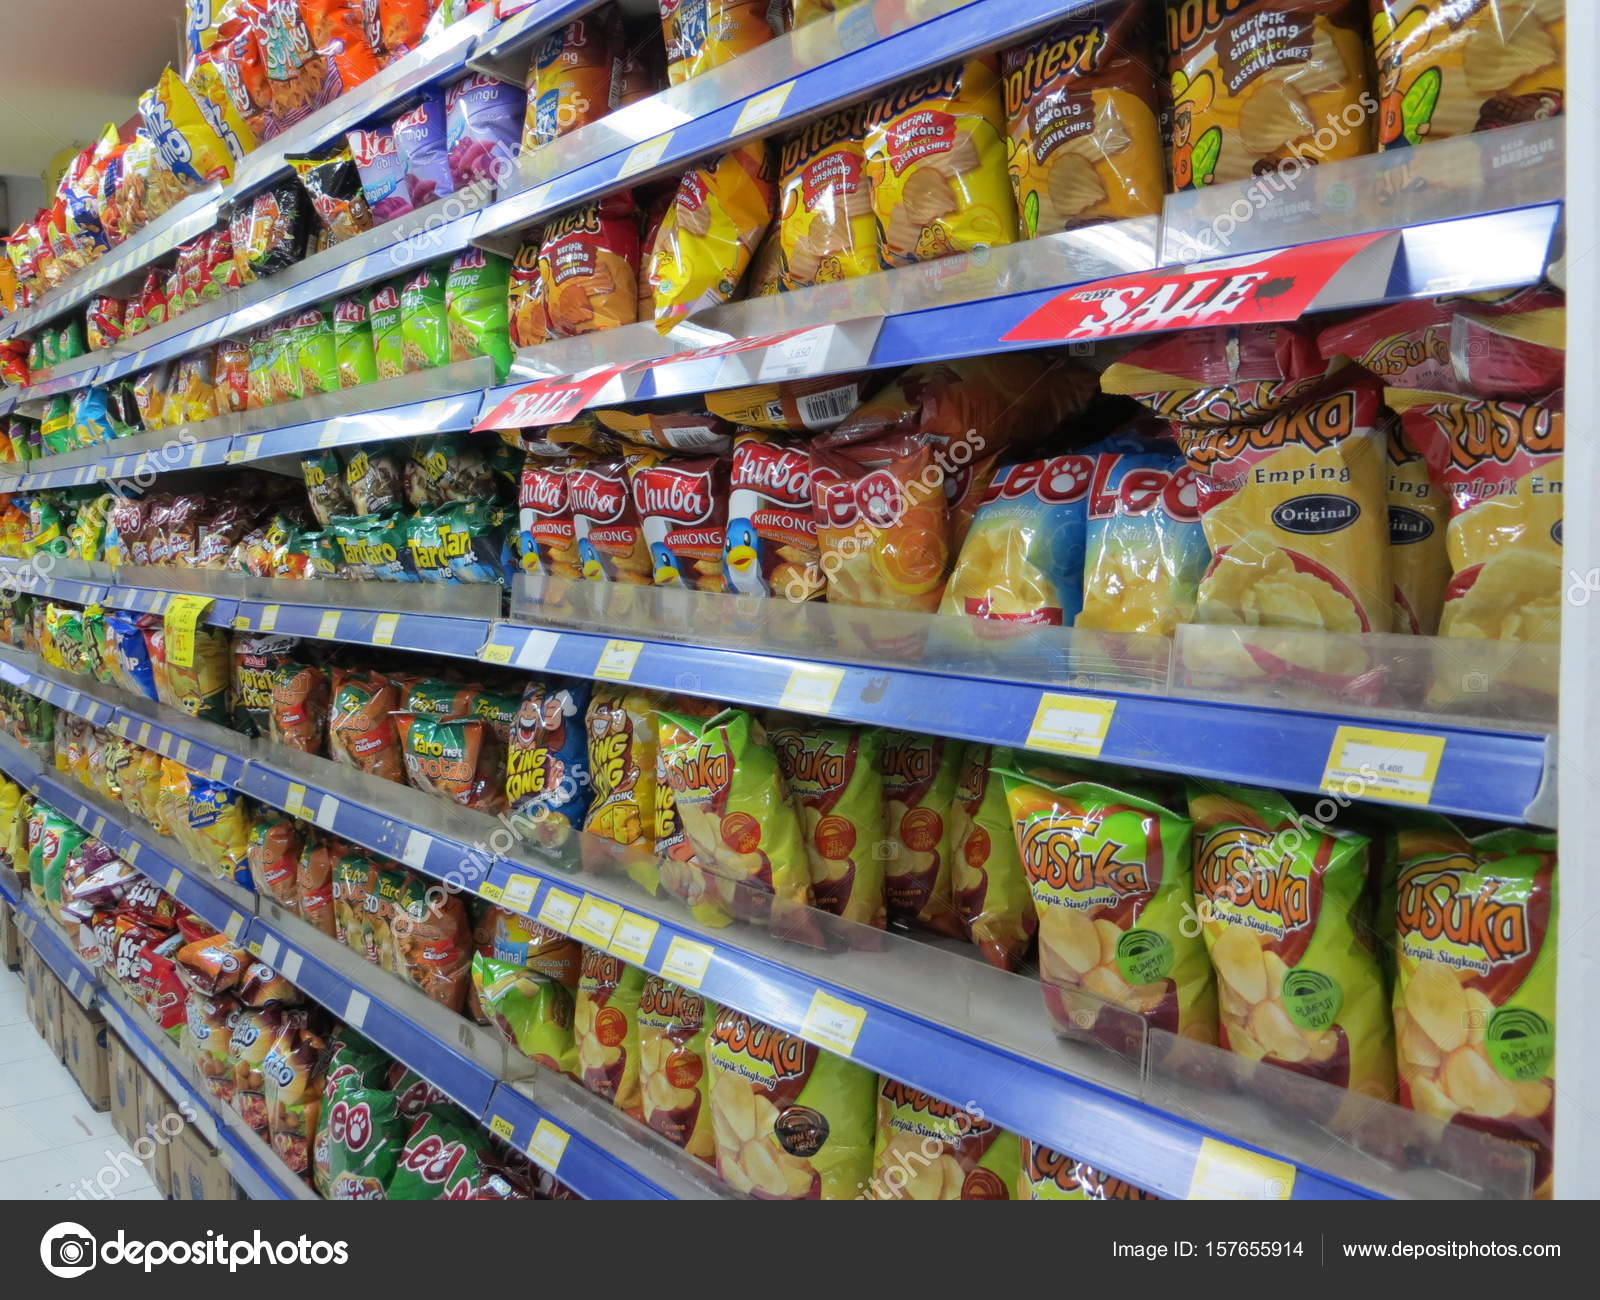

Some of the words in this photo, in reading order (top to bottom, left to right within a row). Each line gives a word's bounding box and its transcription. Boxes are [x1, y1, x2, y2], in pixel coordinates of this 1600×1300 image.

[1230, 12, 1286, 42] keripik
[1230, 25, 1299, 60] singkong
[1231, 52, 1276, 90] CASSAVA
[1276, 48, 1308, 60] CHIPS
[896, 113, 934, 134] keripik
[926, 141, 951, 151] CHIPS
[1037, 128, 1064, 160] CASSAVA
[1064, 121, 1092, 137] CHIPS
[809, 165, 851, 188] singkong
[811, 154, 844, 175] keripik
[506, 386, 580, 424] SALE
[632, 477, 703, 518] Chuba
[1281, 505, 1352, 522] Original
[532, 523, 572, 537] KRIKONG
[589, 530, 633, 542] KRIKONG
[666, 531, 723, 545] KRIKONG
[413, 733, 443, 757] Taro
[506, 748, 548, 776] KING
[1379, 763, 1403, 774] 6,400
[1015, 816, 1151, 896] Kusuka
[1195, 826, 1311, 932] Kusuka
[1031, 888, 1062, 907] Keripik
[1063, 896, 1120, 912] Singkong
[1211, 908, 1244, 927] Keripik
[1244, 917, 1286, 941] Singkong
[1438, 951, 1490, 975] Singkong
[737, 1063, 776, 1091] Singkong
